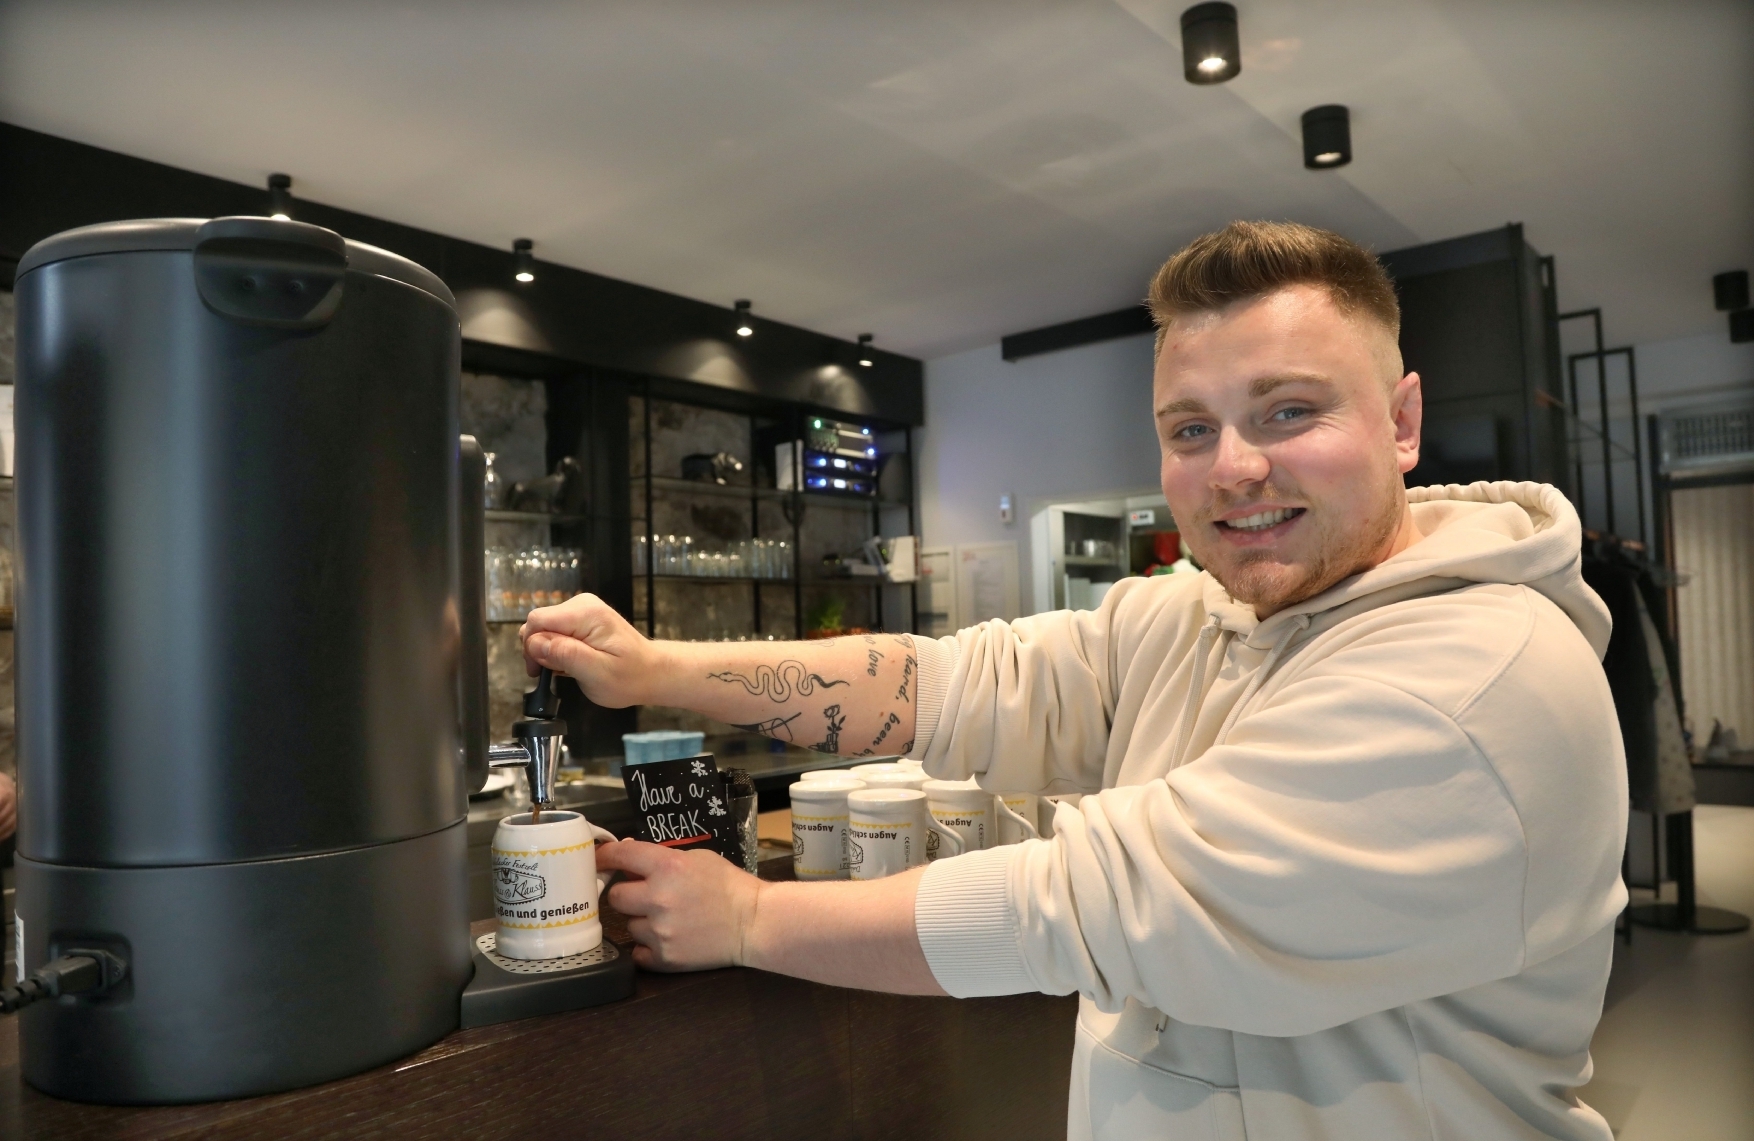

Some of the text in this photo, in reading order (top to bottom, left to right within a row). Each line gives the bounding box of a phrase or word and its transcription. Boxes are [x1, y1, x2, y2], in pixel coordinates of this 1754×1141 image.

[867, 649, 885, 677] love
[872, 712, 901, 746] been
[631, 769, 705, 812] Have a
[808, 823, 834, 833] Augen
[945, 818, 972, 827] Augen
[868, 831, 897, 840] Augen
[516, 908, 537, 919] und
[540, 901, 589, 920] genießen
